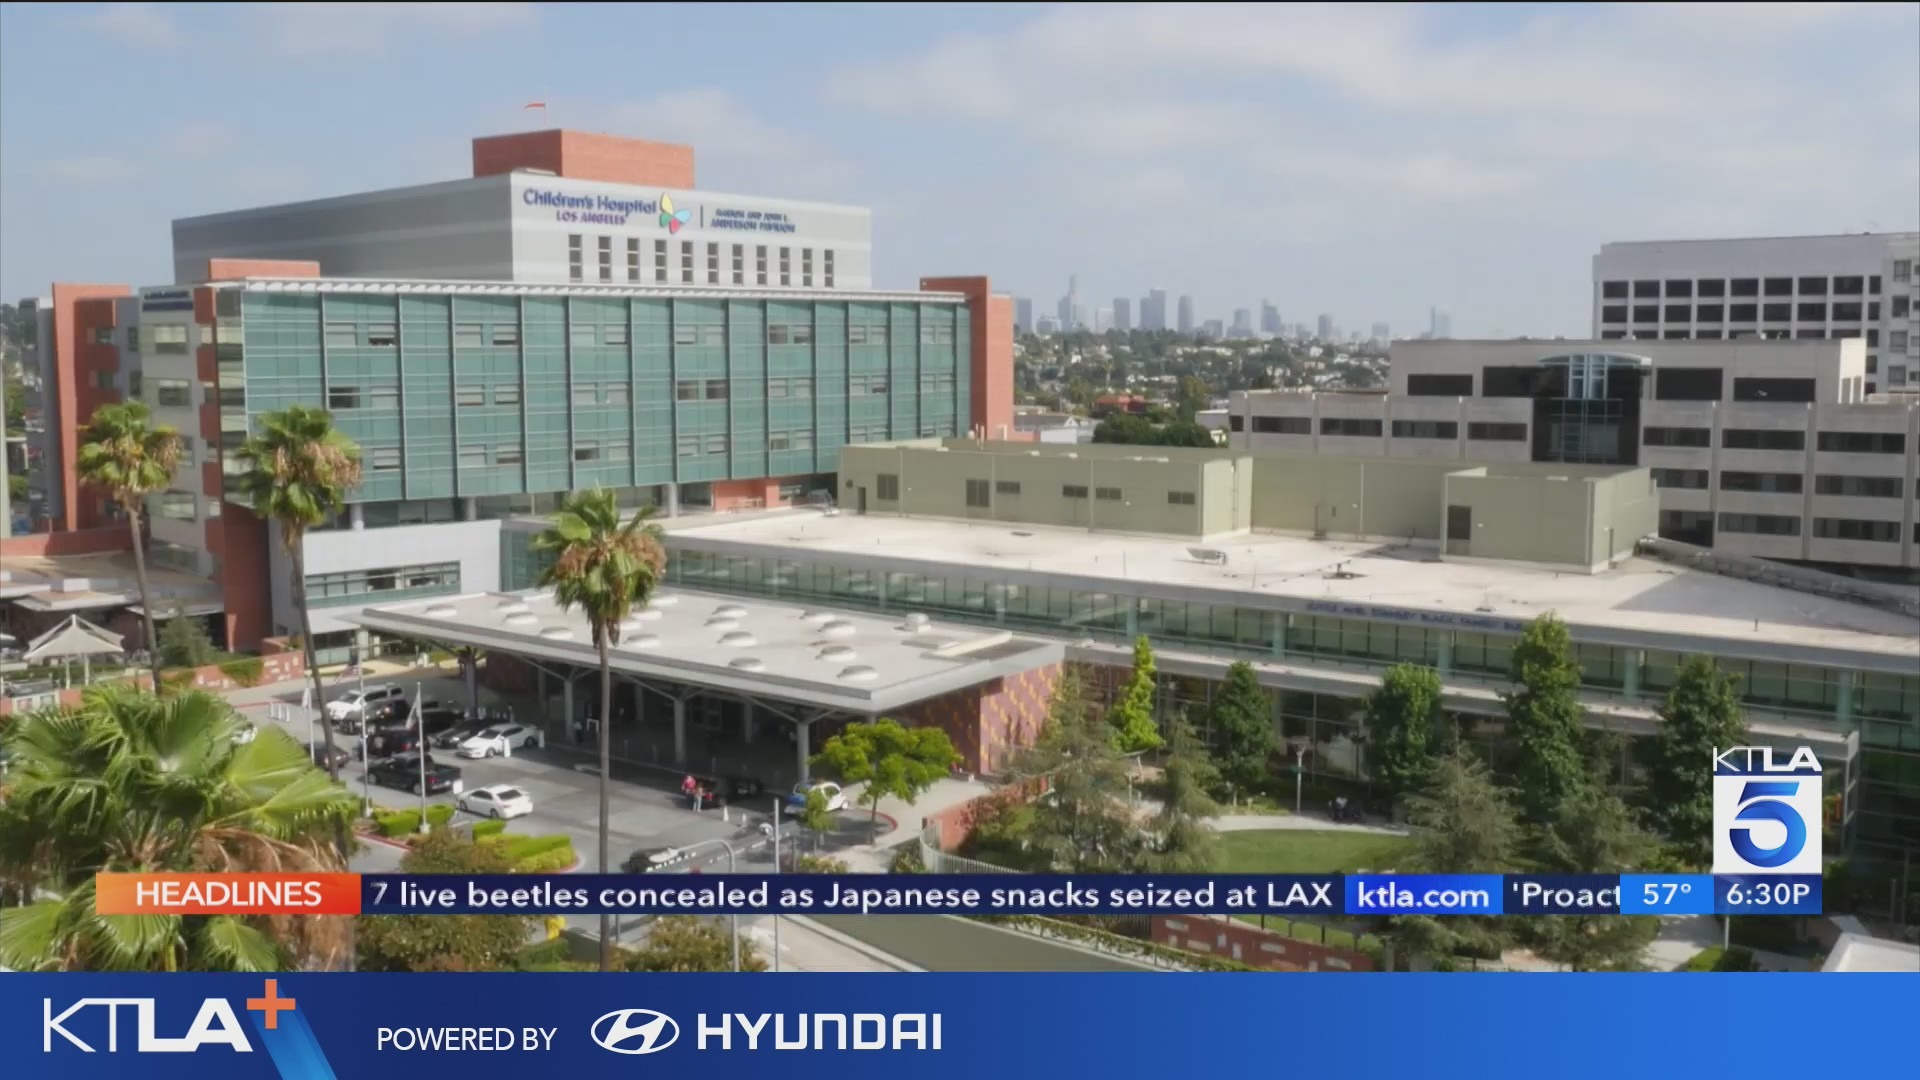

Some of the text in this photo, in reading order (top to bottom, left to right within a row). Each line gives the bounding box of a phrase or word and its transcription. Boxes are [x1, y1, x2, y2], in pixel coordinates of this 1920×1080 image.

[523, 188, 657, 217] Children's Hospital
[556, 210, 626, 226] LOS ANGELES
